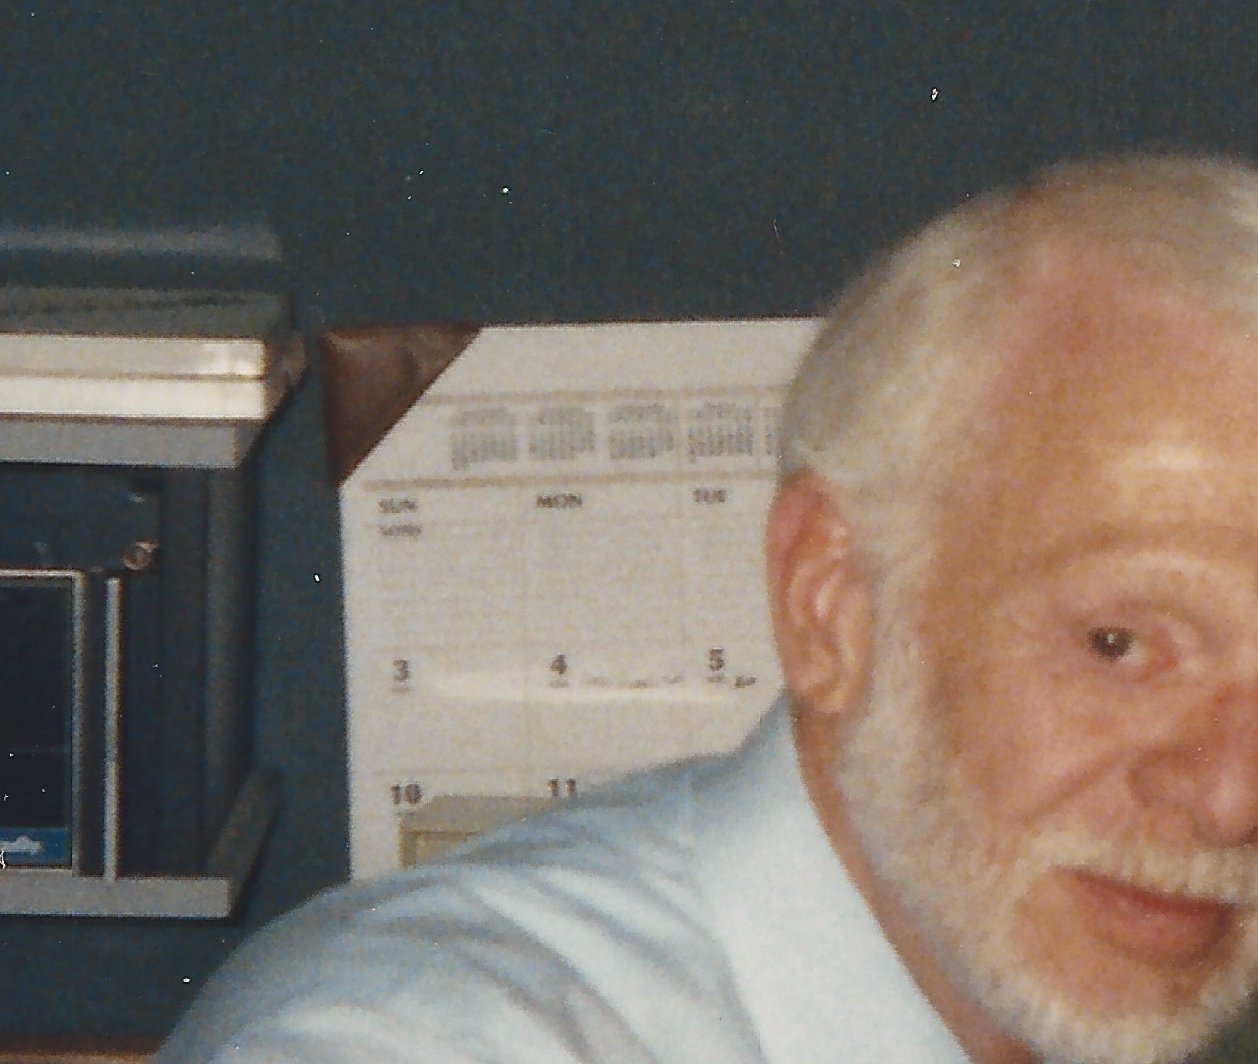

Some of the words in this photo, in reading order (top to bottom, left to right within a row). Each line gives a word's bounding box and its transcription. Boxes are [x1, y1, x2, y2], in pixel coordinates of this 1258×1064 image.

[535, 493, 585, 509] MON
[393, 659, 411, 683] 3
[549, 653, 569, 676] 4
[708, 648, 726, 672] 5
[389, 783, 423, 806] 10
[546, 777, 579, 800] 11
